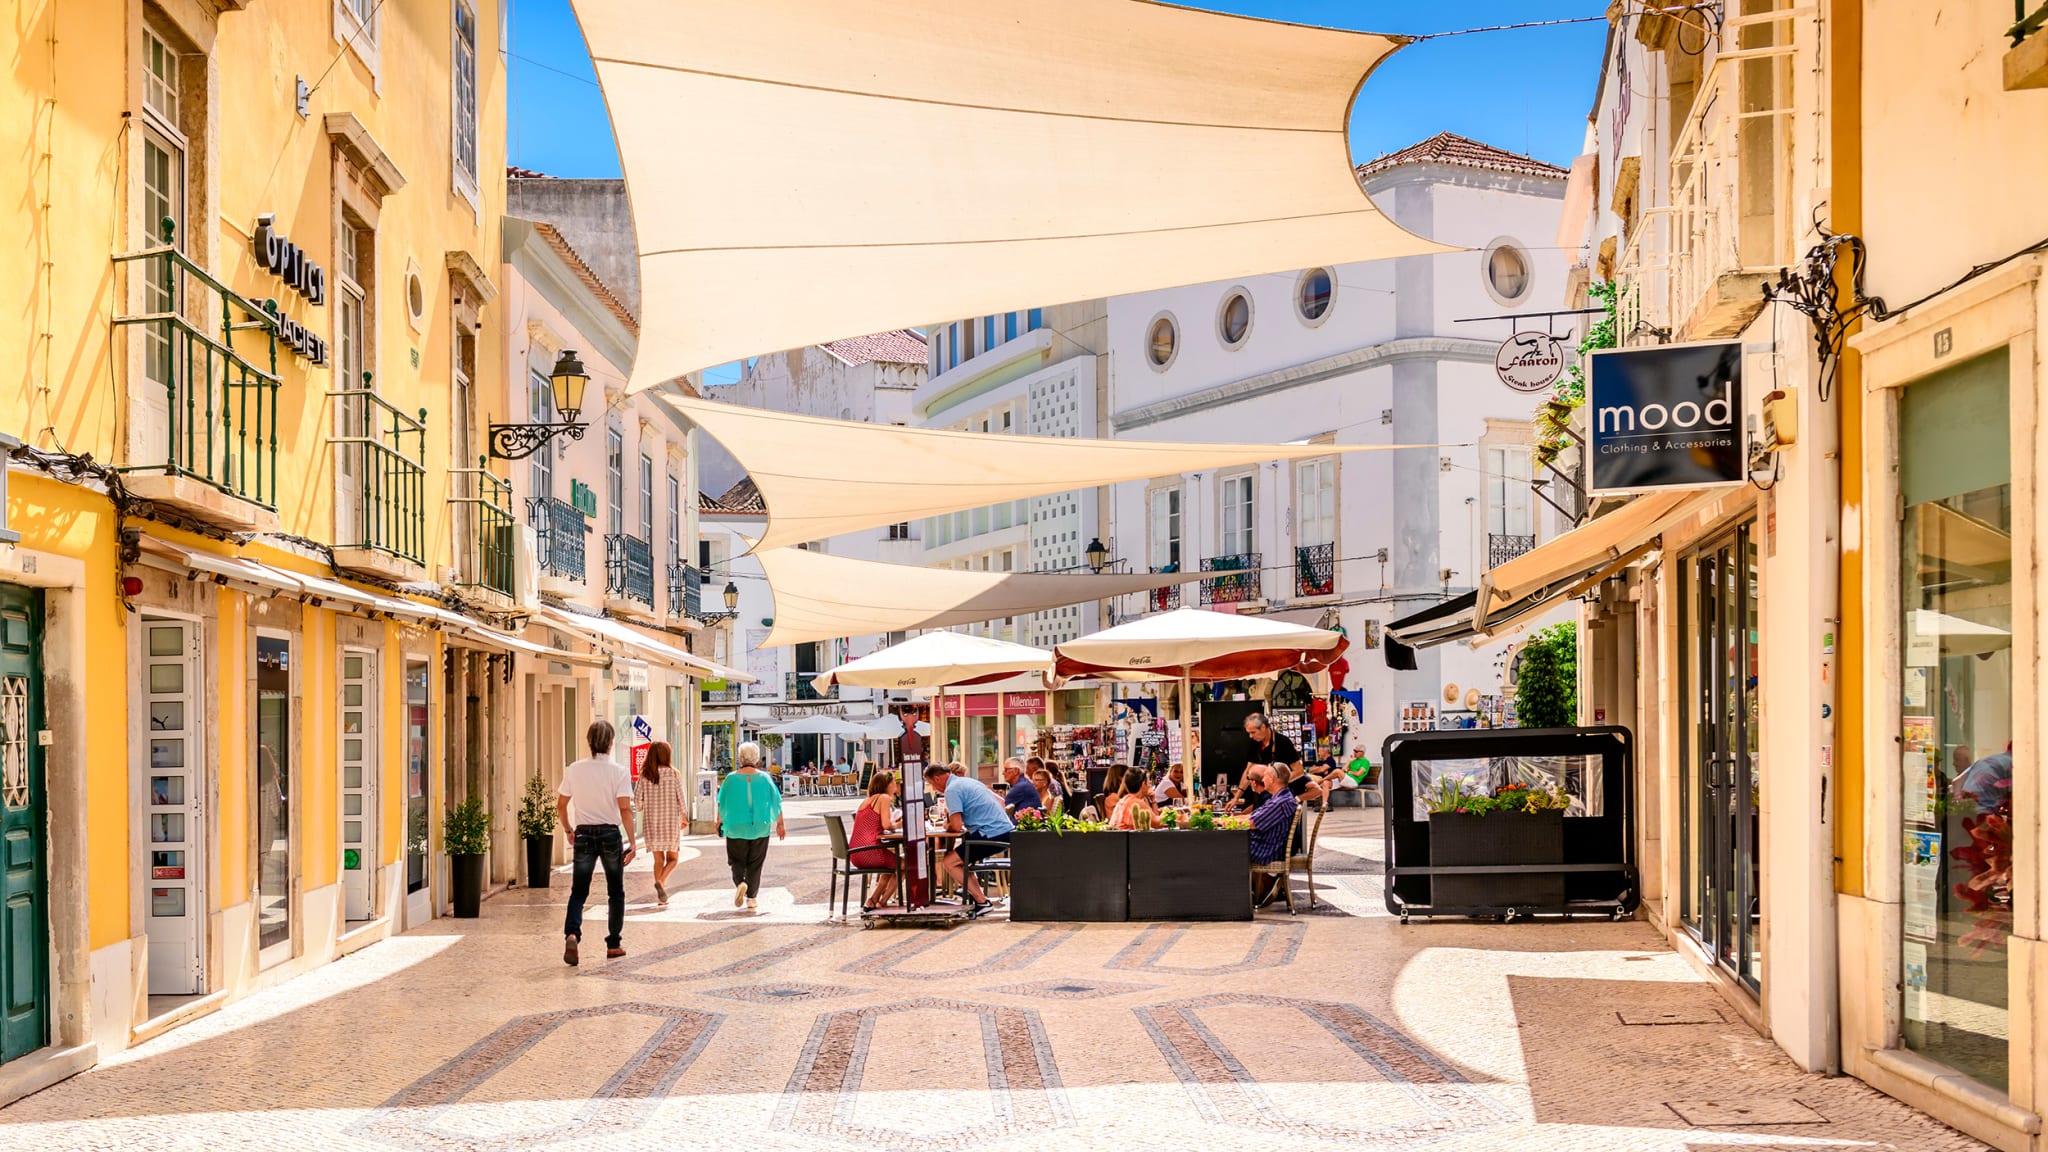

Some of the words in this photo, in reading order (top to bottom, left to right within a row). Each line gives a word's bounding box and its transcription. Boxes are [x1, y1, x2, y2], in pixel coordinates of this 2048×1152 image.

[250, 299, 329, 368] RACIETE
[1599, 381, 1733, 433] mood
[1601, 443, 1648, 454] Clothing
[1652, 441, 1660, 451] &
[1665, 438, 1732, 450] Accessories
[1009, 695, 1041, 707] Millennium
